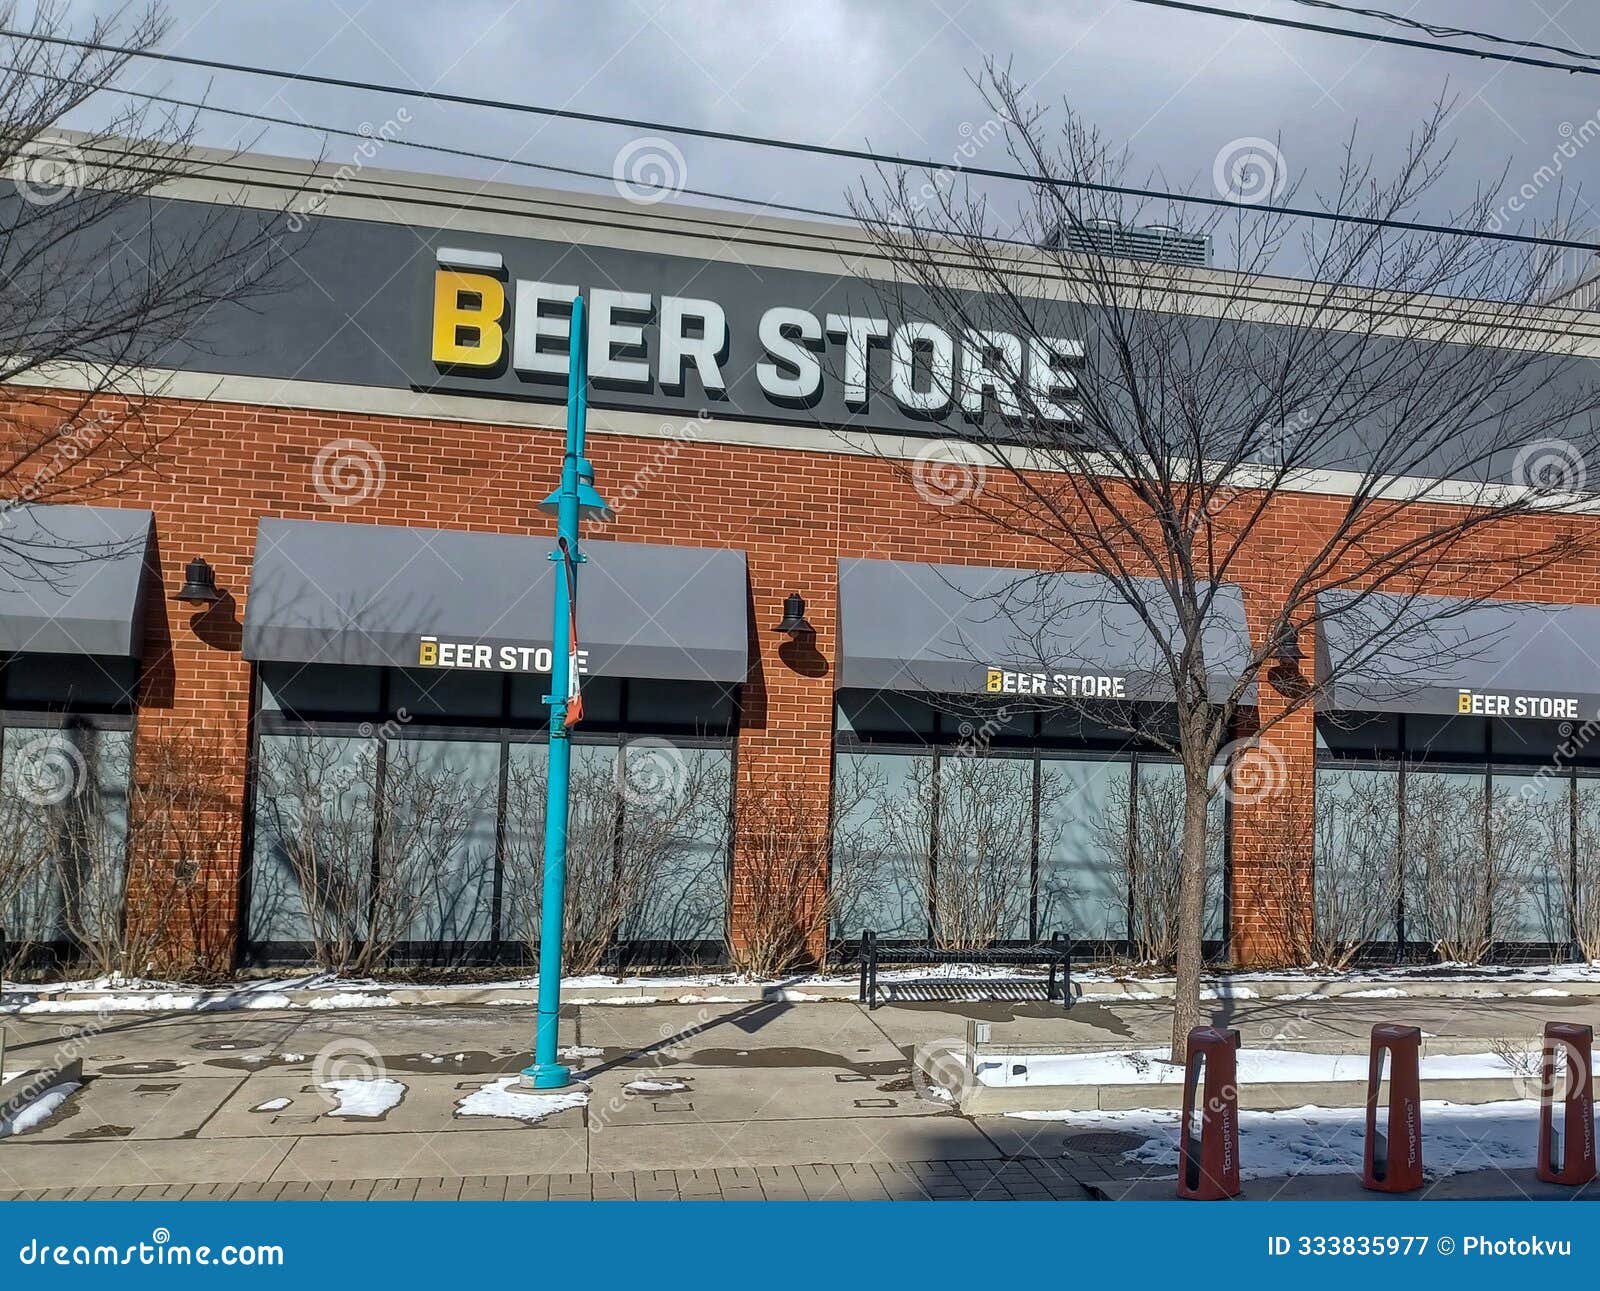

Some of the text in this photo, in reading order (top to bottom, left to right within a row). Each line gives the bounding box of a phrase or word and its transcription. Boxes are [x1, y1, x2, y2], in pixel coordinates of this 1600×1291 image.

[432, 247, 1086, 424] BEER STORE
[419, 637, 589, 673] BEER STOE
[987, 666, 1126, 698] BEER STORE
[1458, 689, 1578, 719] BEER STORE
[1223, 1109, 1232, 1175] Tangerine
[1406, 1103, 1416, 1168] Tangerine
